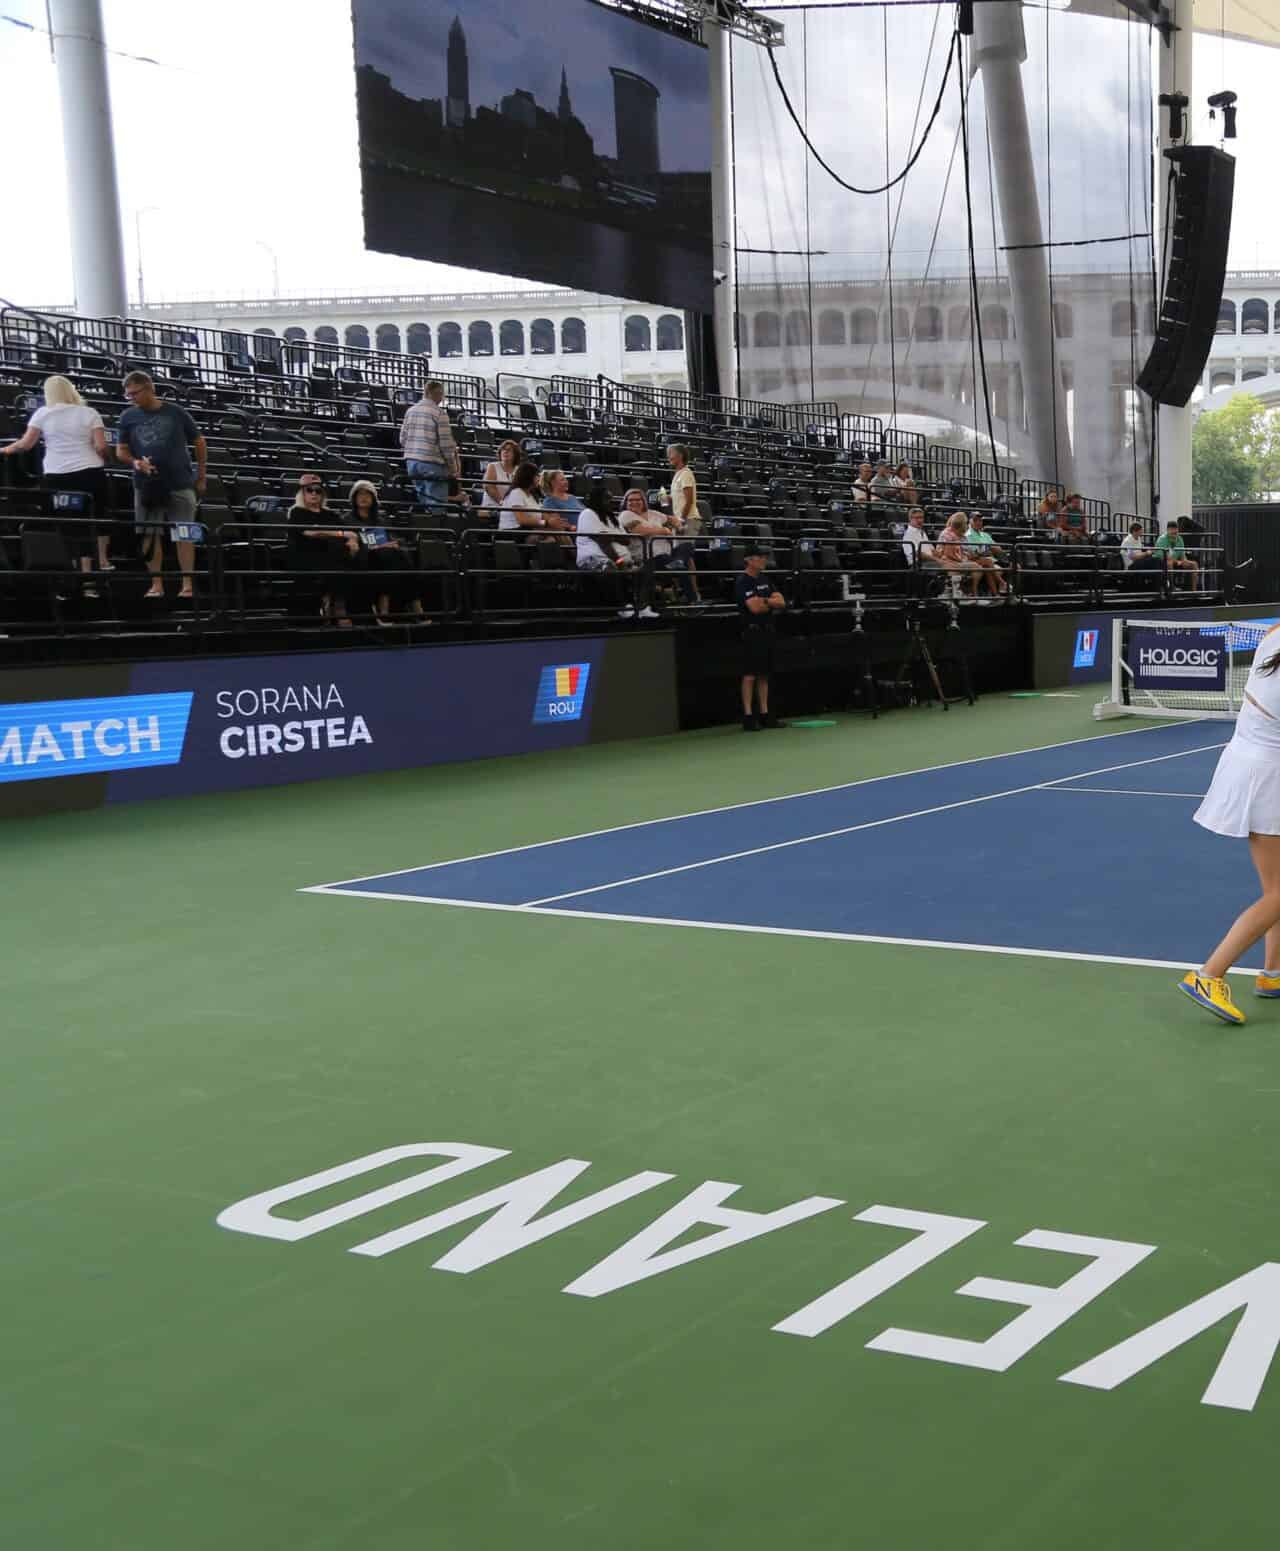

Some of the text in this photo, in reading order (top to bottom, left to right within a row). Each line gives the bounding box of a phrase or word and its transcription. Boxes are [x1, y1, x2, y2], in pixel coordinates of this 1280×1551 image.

[1140, 648, 1218, 665] HOLOGIC
[216, 684, 345, 718] SORANA
[548, 701, 575, 715] ROU
[219, 716, 374, 758] CIRSTEA
